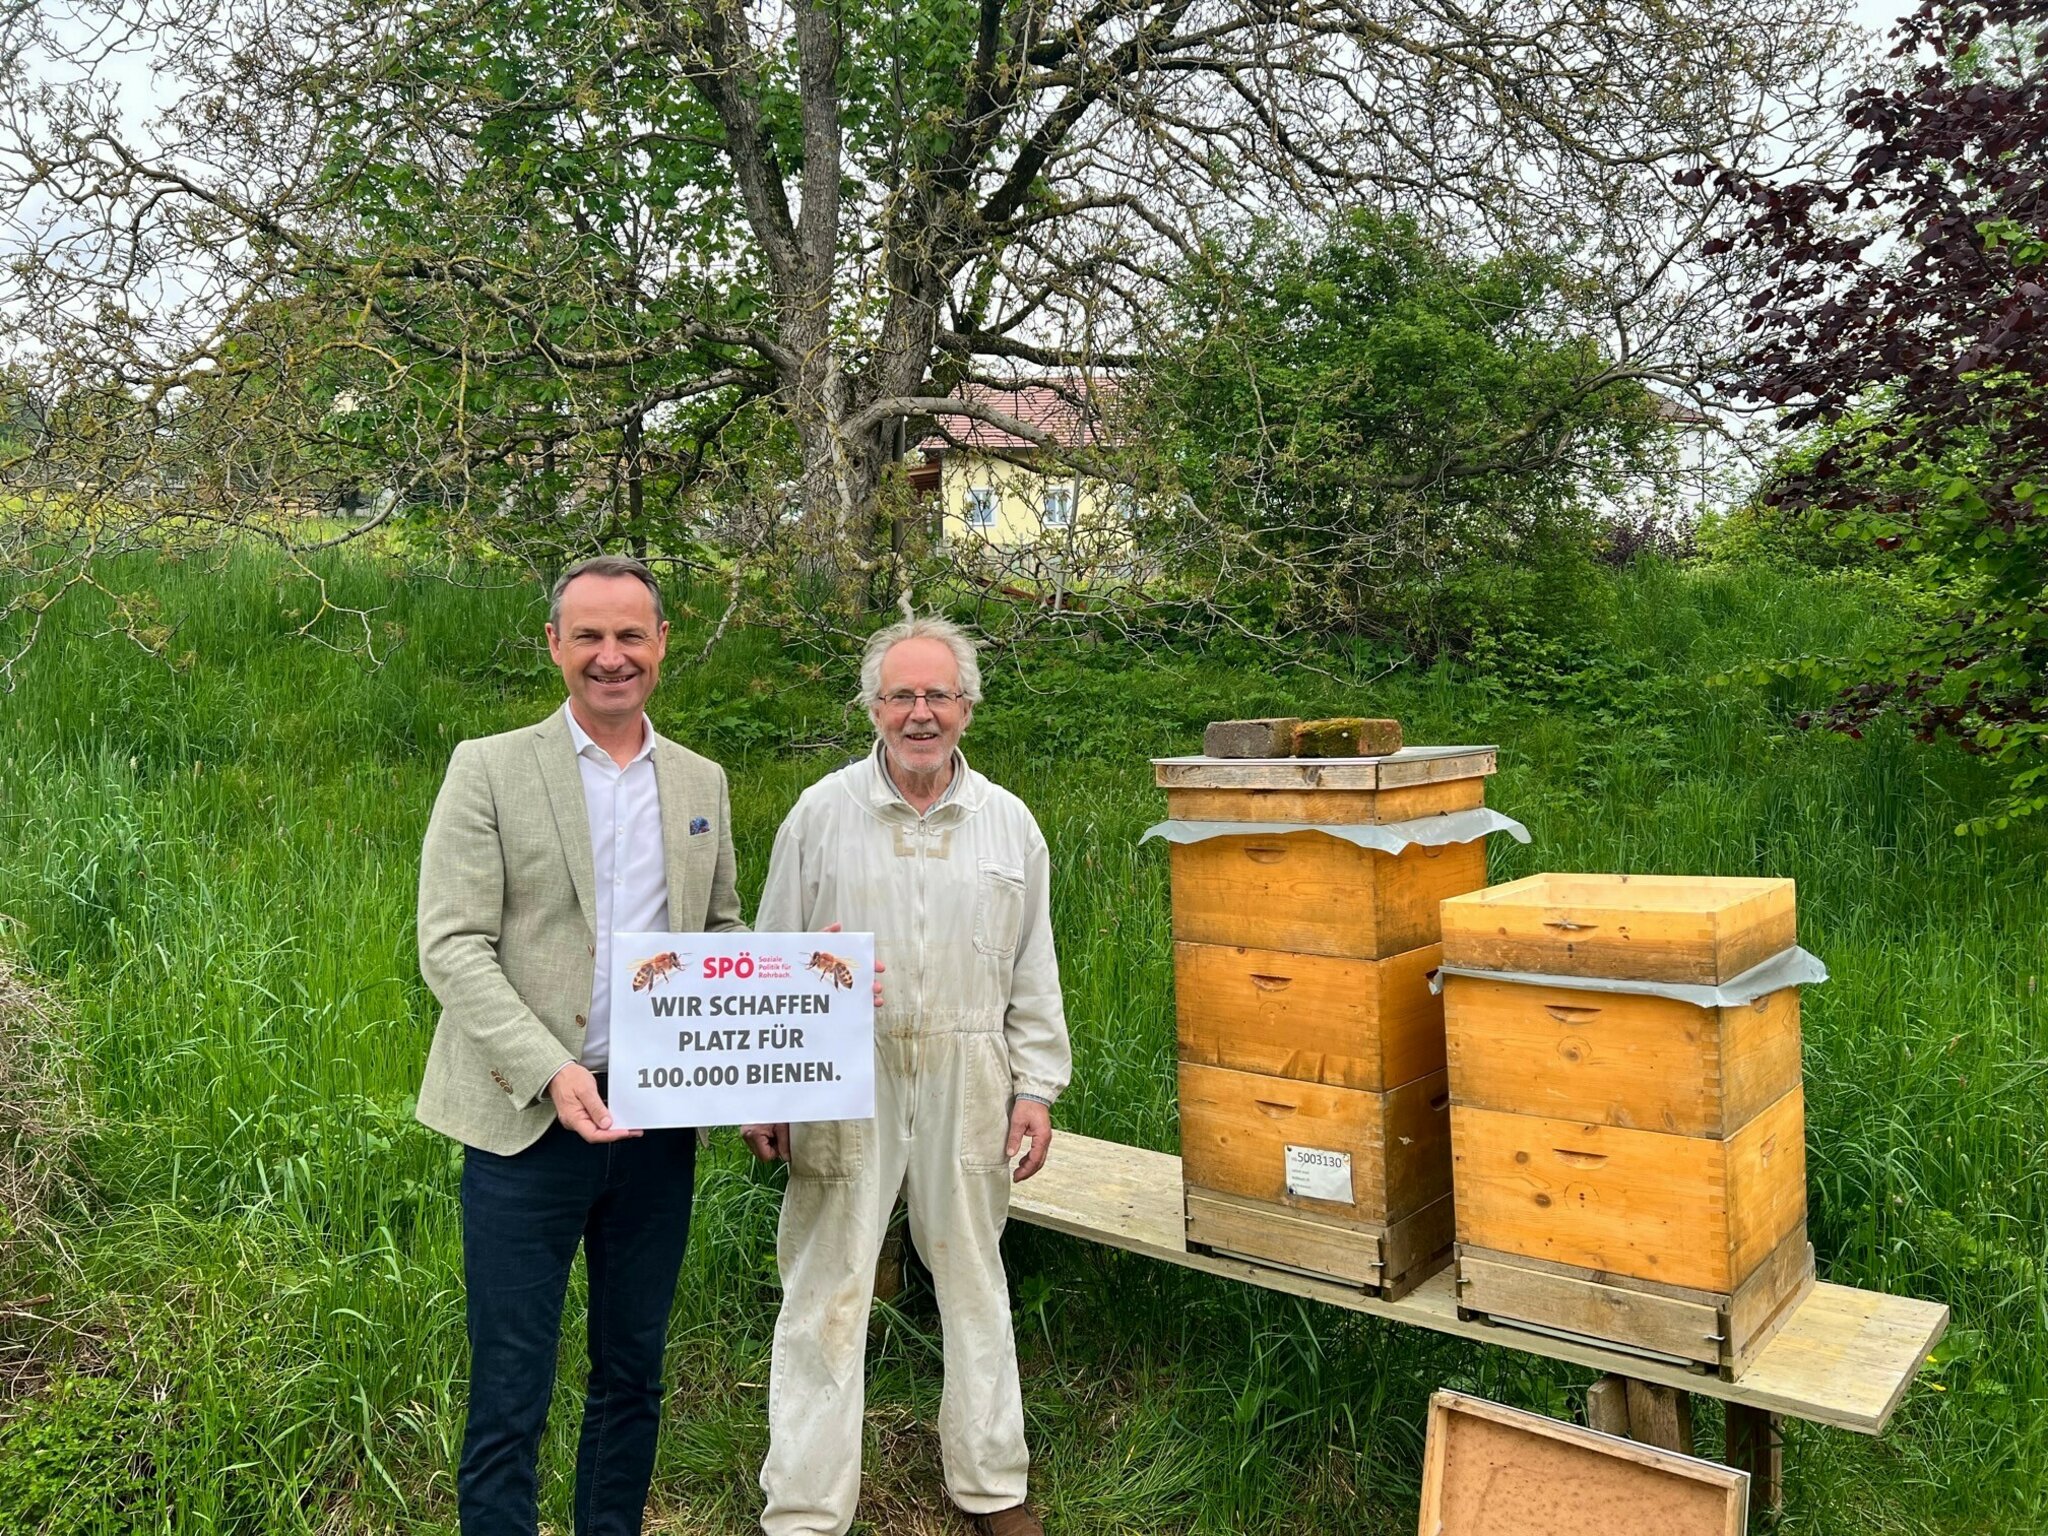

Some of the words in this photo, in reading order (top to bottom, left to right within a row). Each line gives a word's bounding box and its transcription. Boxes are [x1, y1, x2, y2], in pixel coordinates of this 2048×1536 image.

[703, 951, 754, 979] SPÖ
[758, 963, 780, 971] Politik
[758, 971, 792, 979] Rohrbach.
[651, 996, 702, 1017] WIR
[709, 994, 830, 1016] SCHAFFEN
[679, 1030, 751, 1051] PLATZ
[759, 1024, 804, 1049] FÜR
[638, 1065, 739, 1088] 100.000
[746, 1061, 842, 1084] BIENEN.
[1297, 1152, 1342, 1168] 5003130
